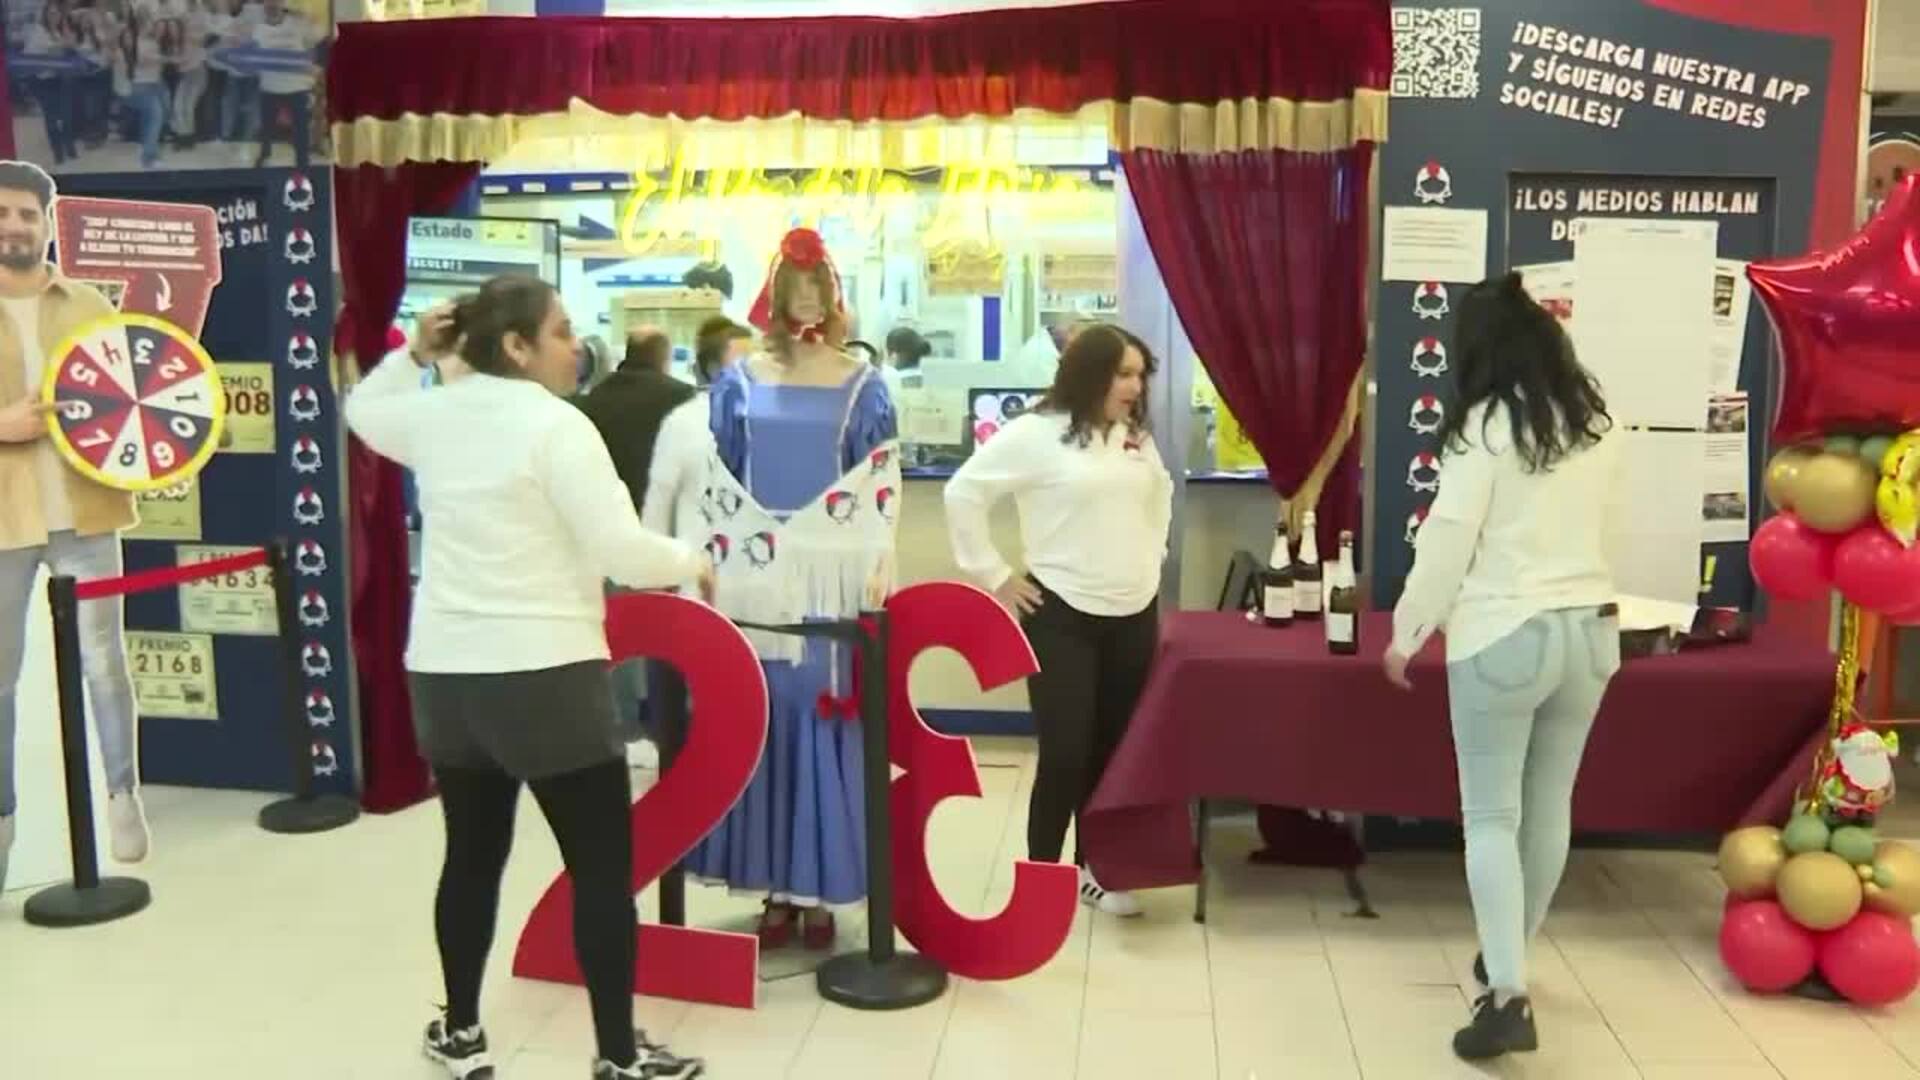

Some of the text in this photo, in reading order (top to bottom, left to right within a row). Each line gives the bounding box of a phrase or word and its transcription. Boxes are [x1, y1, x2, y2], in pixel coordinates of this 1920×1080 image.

[1511, 21, 1810, 105] ¡DESCARGA NUESTRA APP
[1507, 52, 1767, 129] Y SÍGUENOS EN REDES
[1499, 82, 1625, 129] SOCIALES!
[1514, 188, 1759, 214] ¡LOS MEDIOS HABLAN
[411, 221, 473, 239] Estado
[134, 337, 155, 365] 3
[68, 362, 99, 387] 5
[158, 356, 189, 380] 2
[119, 443, 138, 467] 8
[139, 639, 193, 652] PREMIO
[135, 654, 203, 674] 2168
